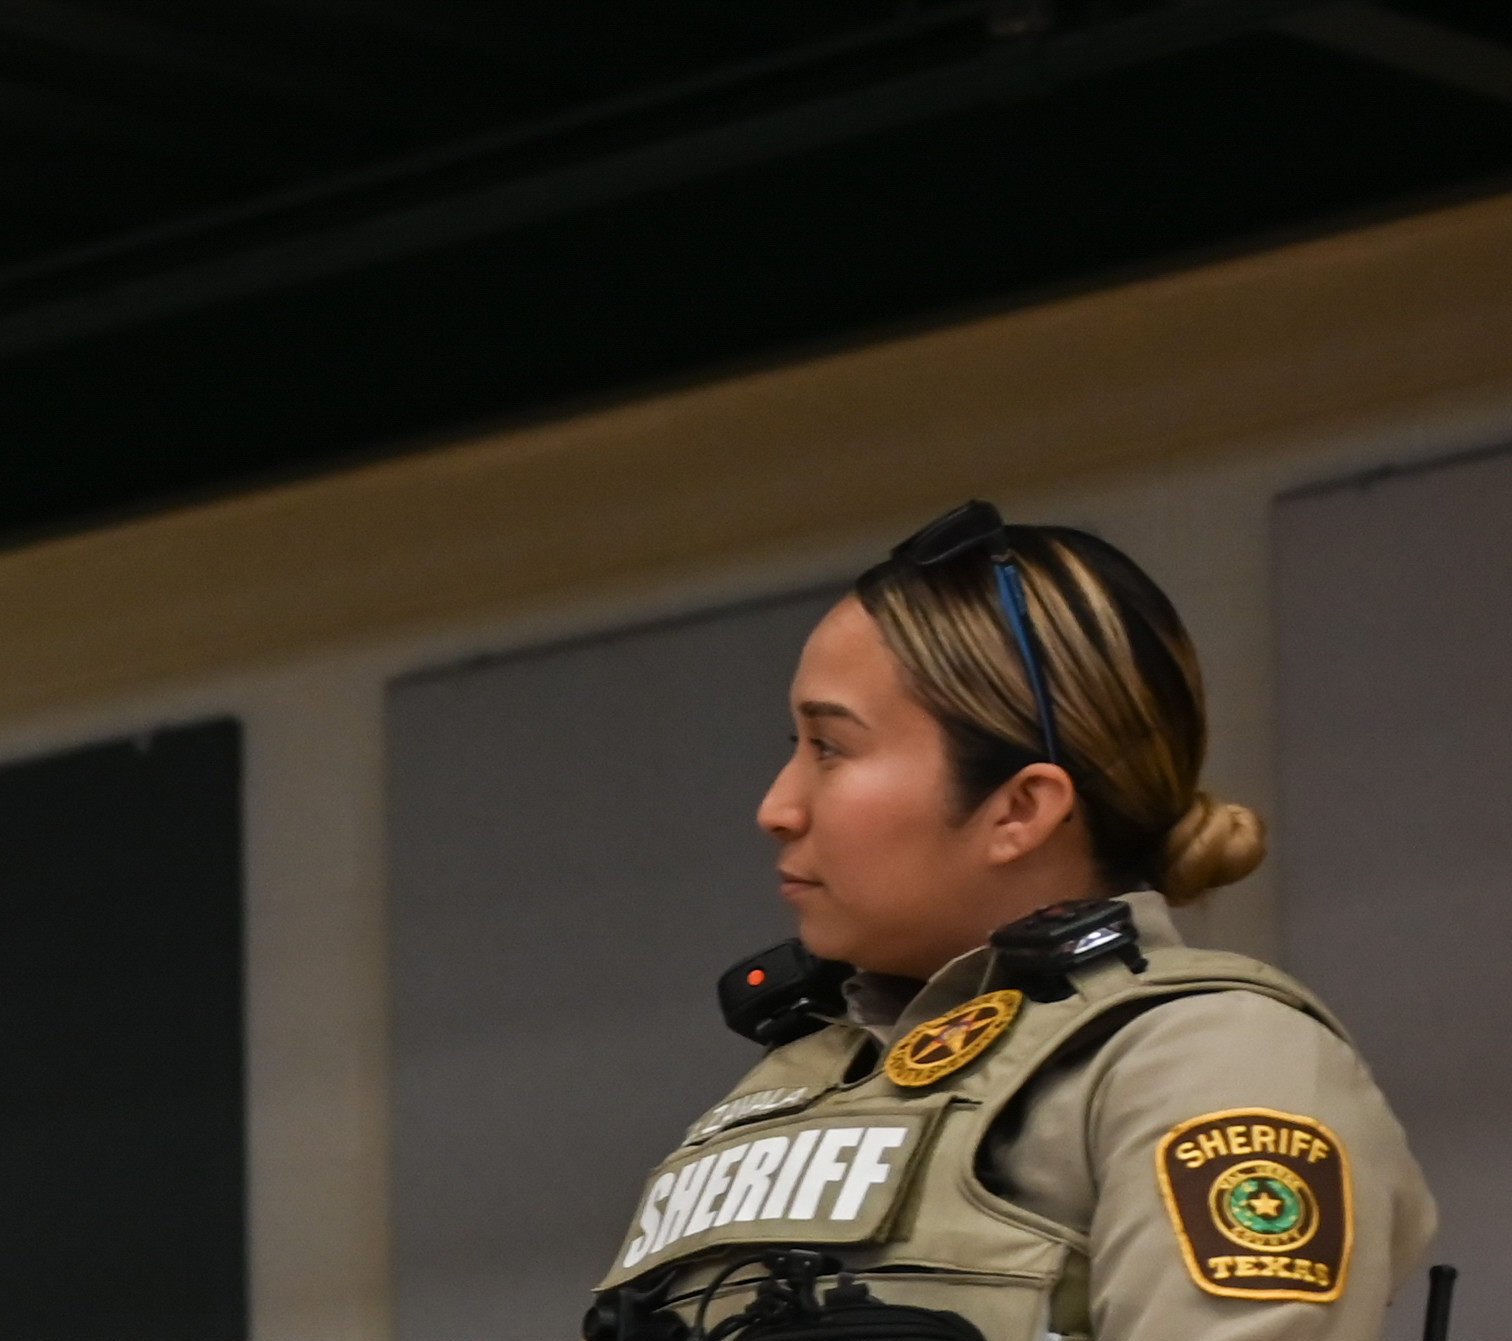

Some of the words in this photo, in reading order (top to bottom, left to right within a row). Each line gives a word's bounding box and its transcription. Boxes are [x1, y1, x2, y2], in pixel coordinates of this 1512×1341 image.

[1175, 1124, 1331, 1168] SHERIFF
[622, 1126, 908, 1268] SHERIFF
[1207, 1255, 1331, 1287] TEXAS
